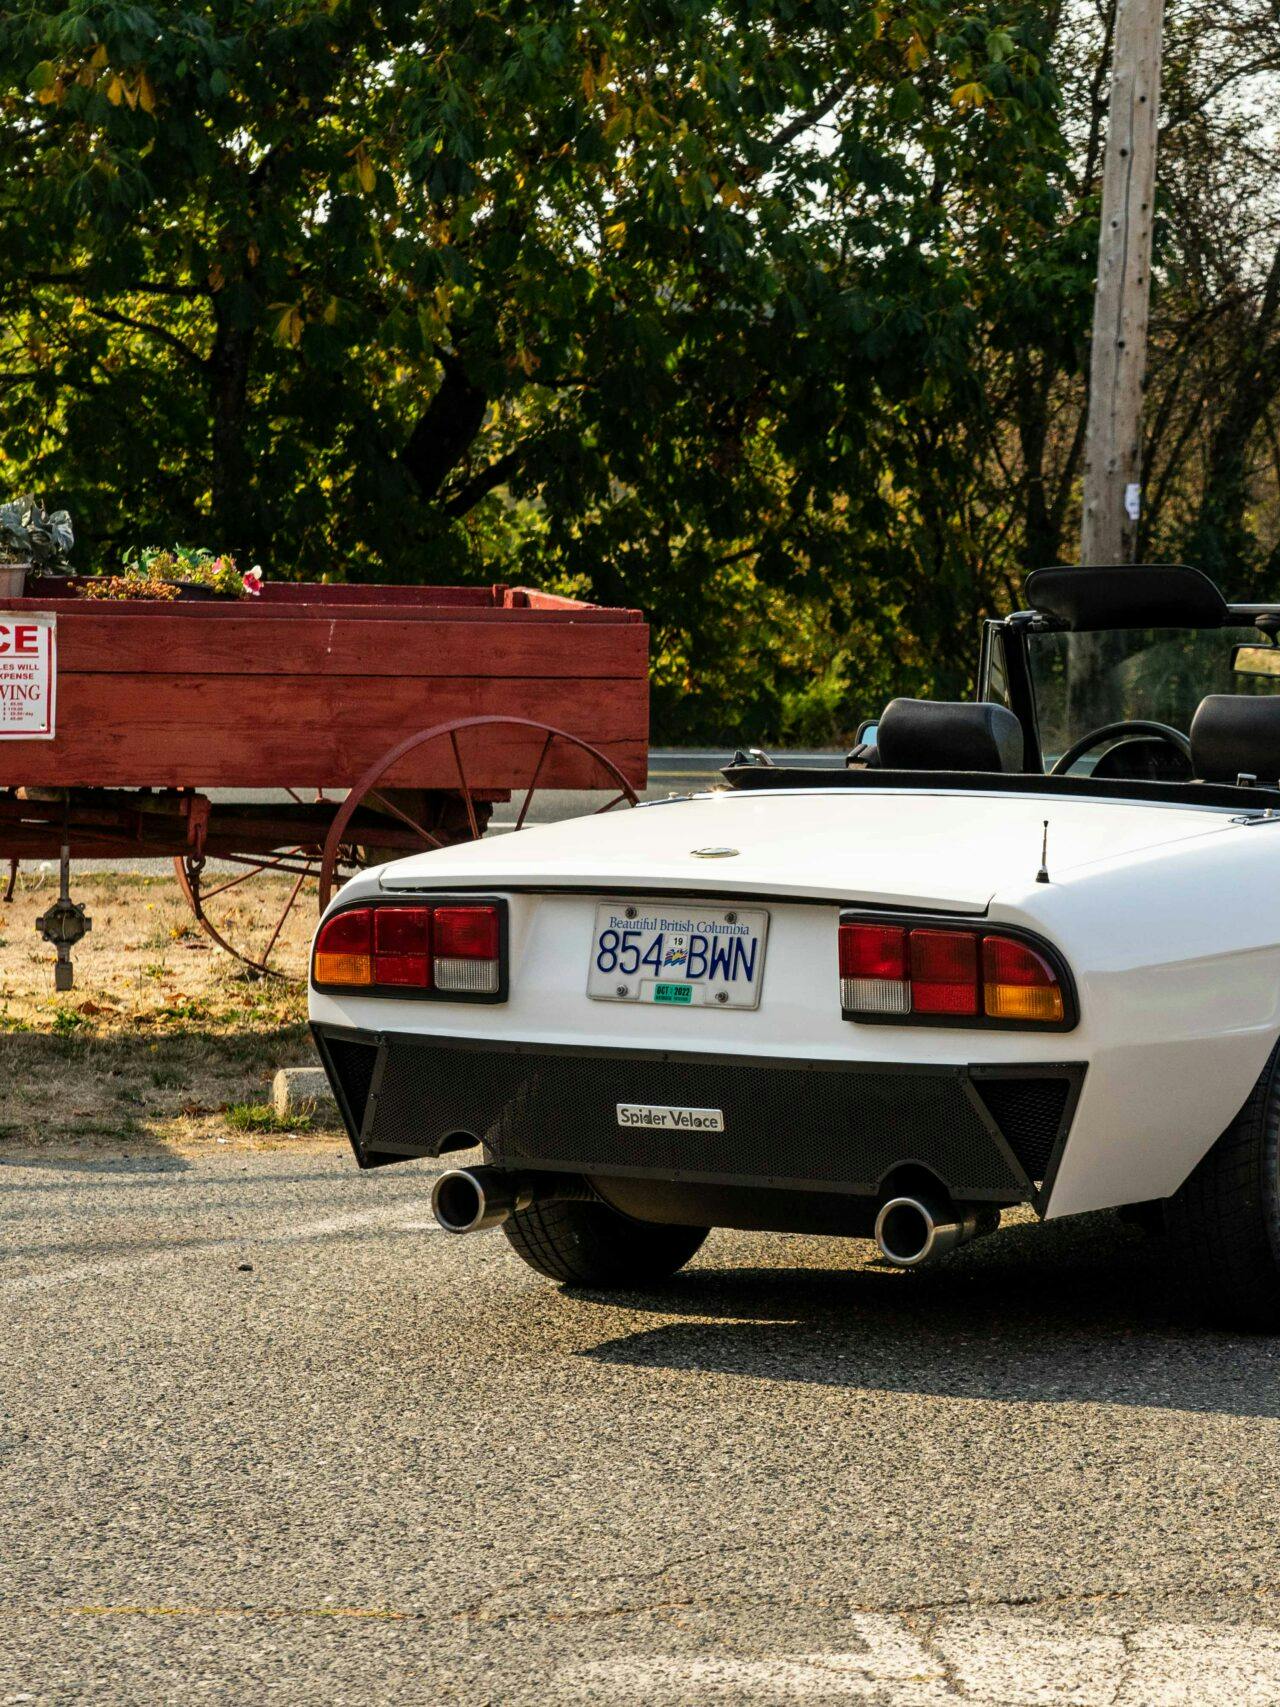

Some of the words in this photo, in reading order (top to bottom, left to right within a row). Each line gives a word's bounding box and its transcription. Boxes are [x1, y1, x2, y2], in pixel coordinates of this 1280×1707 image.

[609, 916, 657, 930] Beautiful
[660, 919, 694, 933] British
[696, 921, 750, 935] Columbia
[674, 937, 684, 946] 19
[596, 929, 665, 977] 854
[685, 935, 758, 982] BWN
[656, 985, 670, 995] OCT
[674, 986, 690, 997] 2022
[620, 1108, 667, 1125] Spider
[669, 1110, 719, 1128] Veloce
